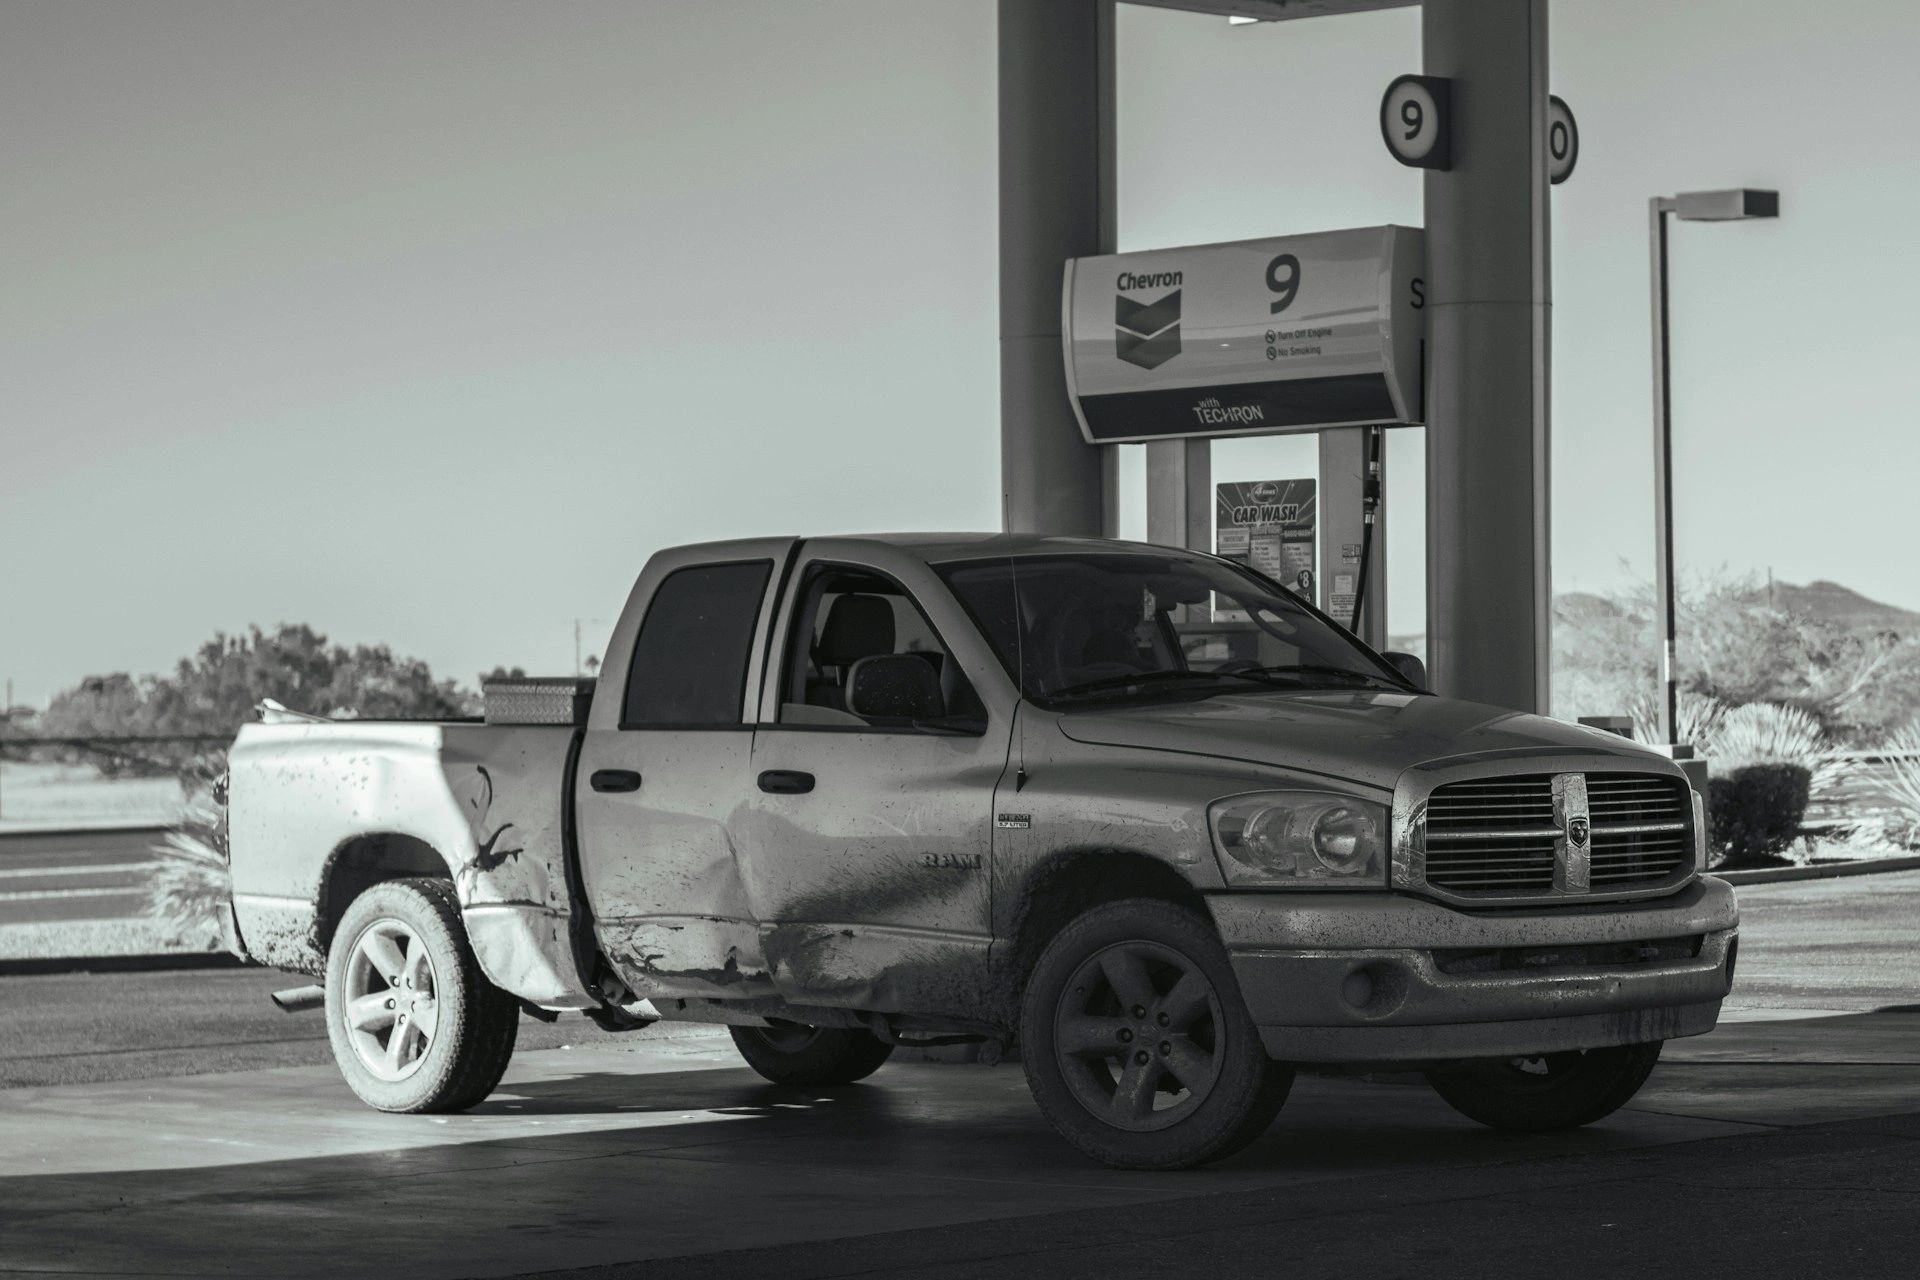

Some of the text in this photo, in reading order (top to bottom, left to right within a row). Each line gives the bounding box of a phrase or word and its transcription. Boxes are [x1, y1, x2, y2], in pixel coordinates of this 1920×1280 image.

[1401, 100, 1423, 140] 9
[1116, 270, 1183, 291] Chevron
[1265, 253, 1300, 315] 9
[1277, 328, 1333, 340] Turn Off Engine
[1278, 345, 1322, 356] No Smoking
[1198, 396, 1220, 408] with
[1192, 405, 1264, 424] TECHRON
[1233, 504, 1298, 523] CAR WASH
